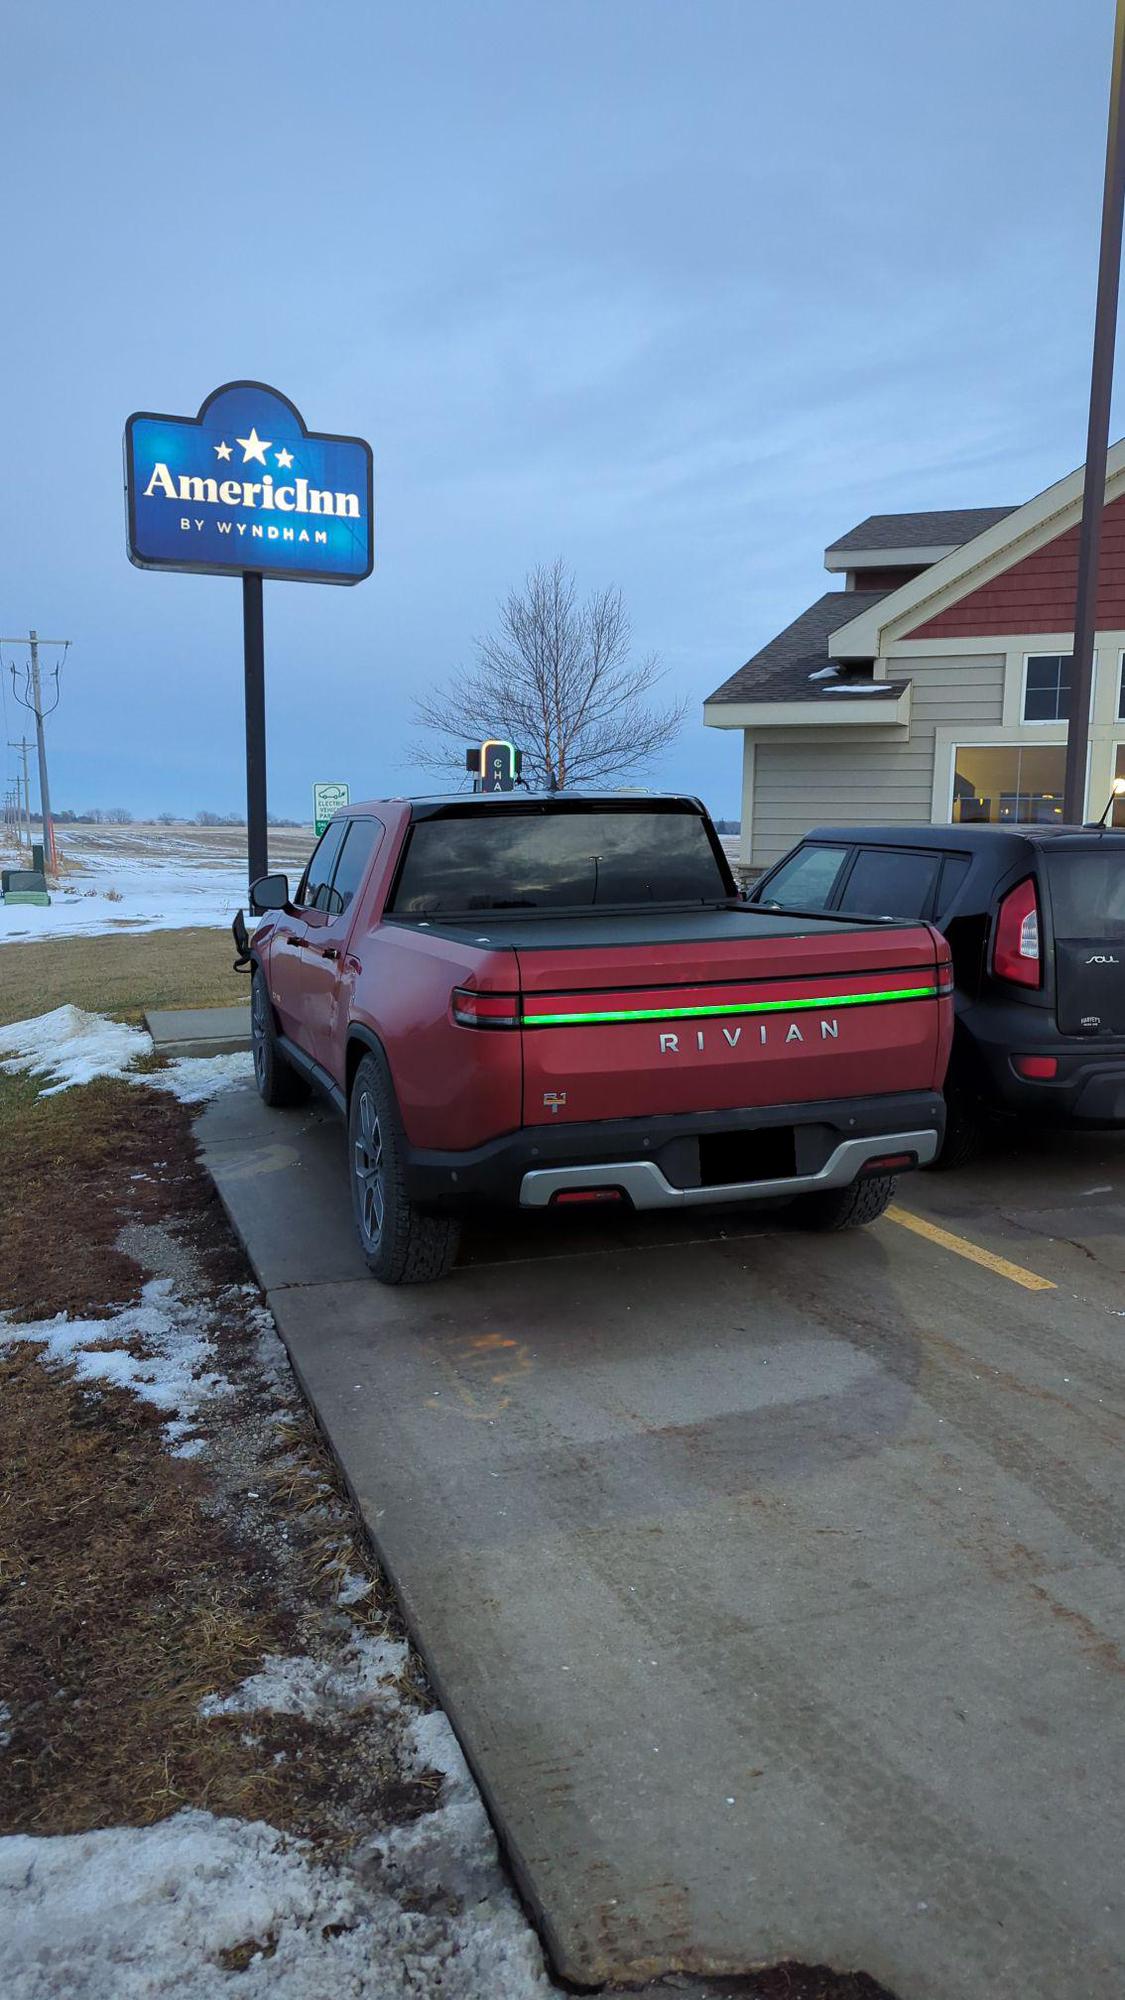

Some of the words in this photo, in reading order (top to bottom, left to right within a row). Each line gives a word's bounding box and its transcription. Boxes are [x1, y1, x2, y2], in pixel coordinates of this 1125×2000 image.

[142, 462, 361, 518] AmericInn
[180, 518, 205, 531] BY
[217, 521, 328, 544] WYNDHAM
[659, 1019, 840, 1053] RIVIAN
